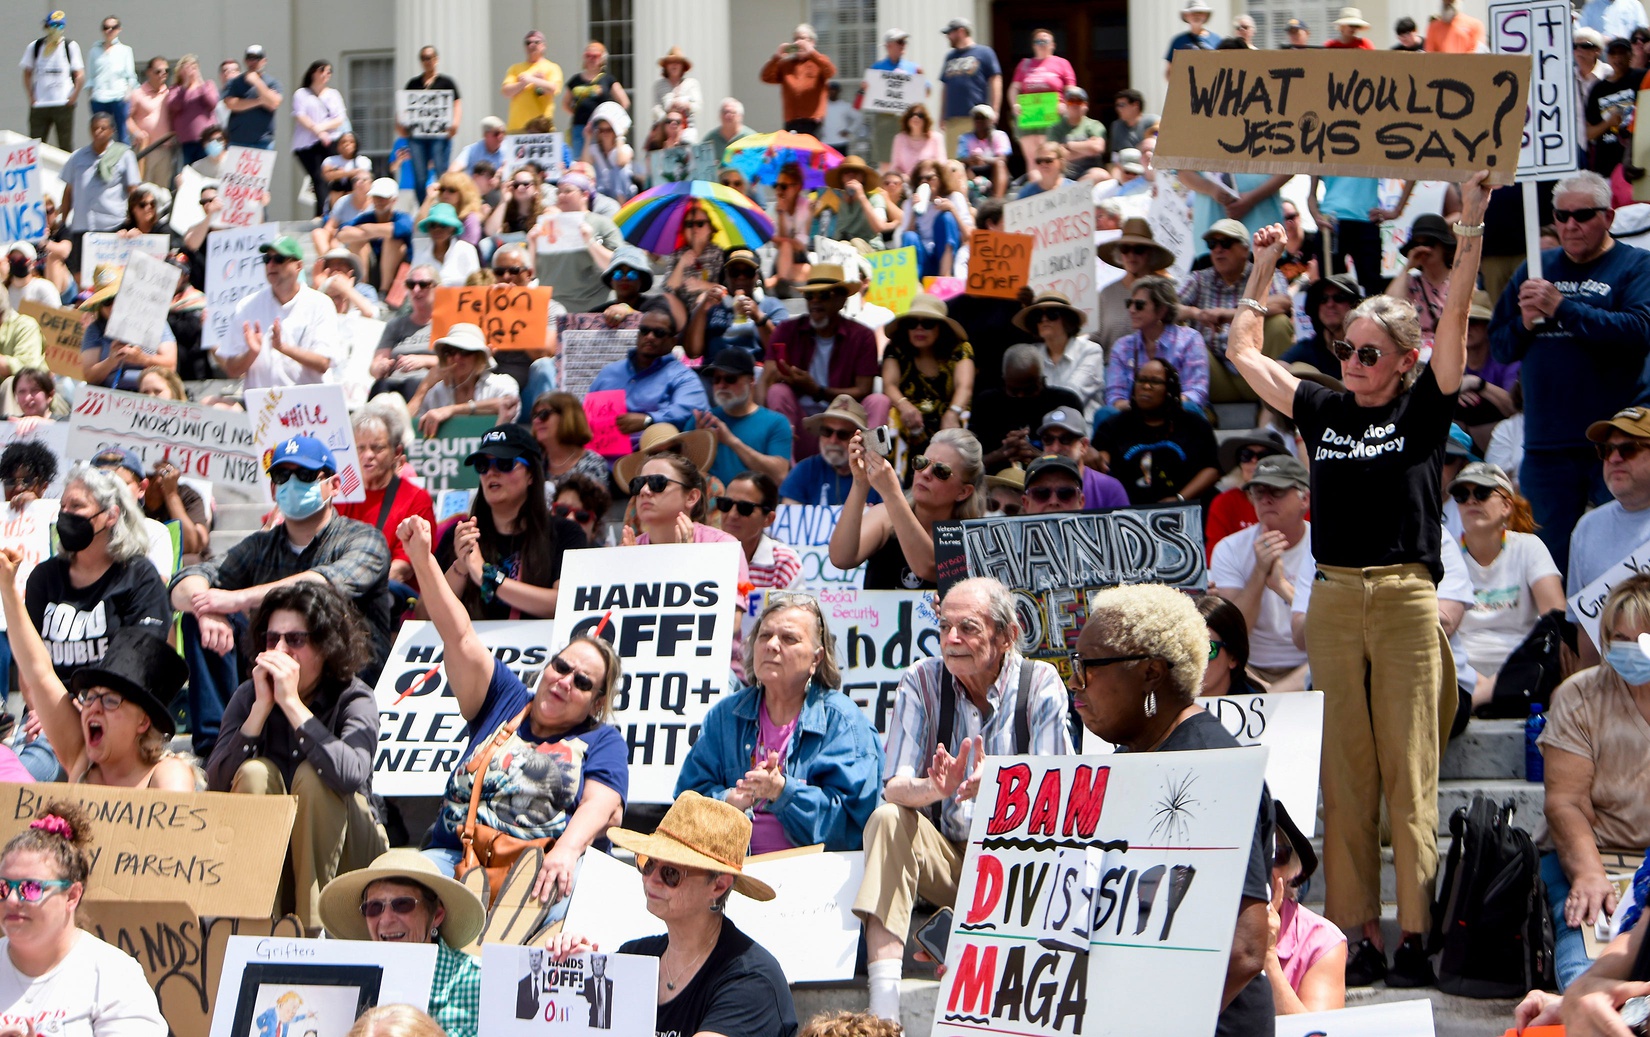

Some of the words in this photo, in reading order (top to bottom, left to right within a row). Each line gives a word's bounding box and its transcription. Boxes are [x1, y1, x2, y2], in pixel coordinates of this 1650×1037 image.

[1188, 66, 1305, 118] WHAT
[1327, 69, 1475, 120] WOULD
[1217, 117, 1361, 163] JESUS
[1015, 210, 1092, 250] NGRESS
[407, 436, 483, 460] EQUIT
[1315, 445, 1347, 461] Love
[1348, 436, 1405, 459] Mercy
[965, 509, 1204, 592] HANDS
[573, 580, 720, 612] HANDS
[832, 604, 879, 628] Security
[570, 614, 717, 658] OFF!
[986, 762, 1111, 839] BAN
[113, 851, 225, 886] PARENTS
[97, 920, 200, 973] ANDS
[255, 938, 316, 960] Grifters
[547, 955, 584, 970] HANDS
[546, 969, 584, 988] OFF!
[946, 943, 1088, 1035] MAGA
